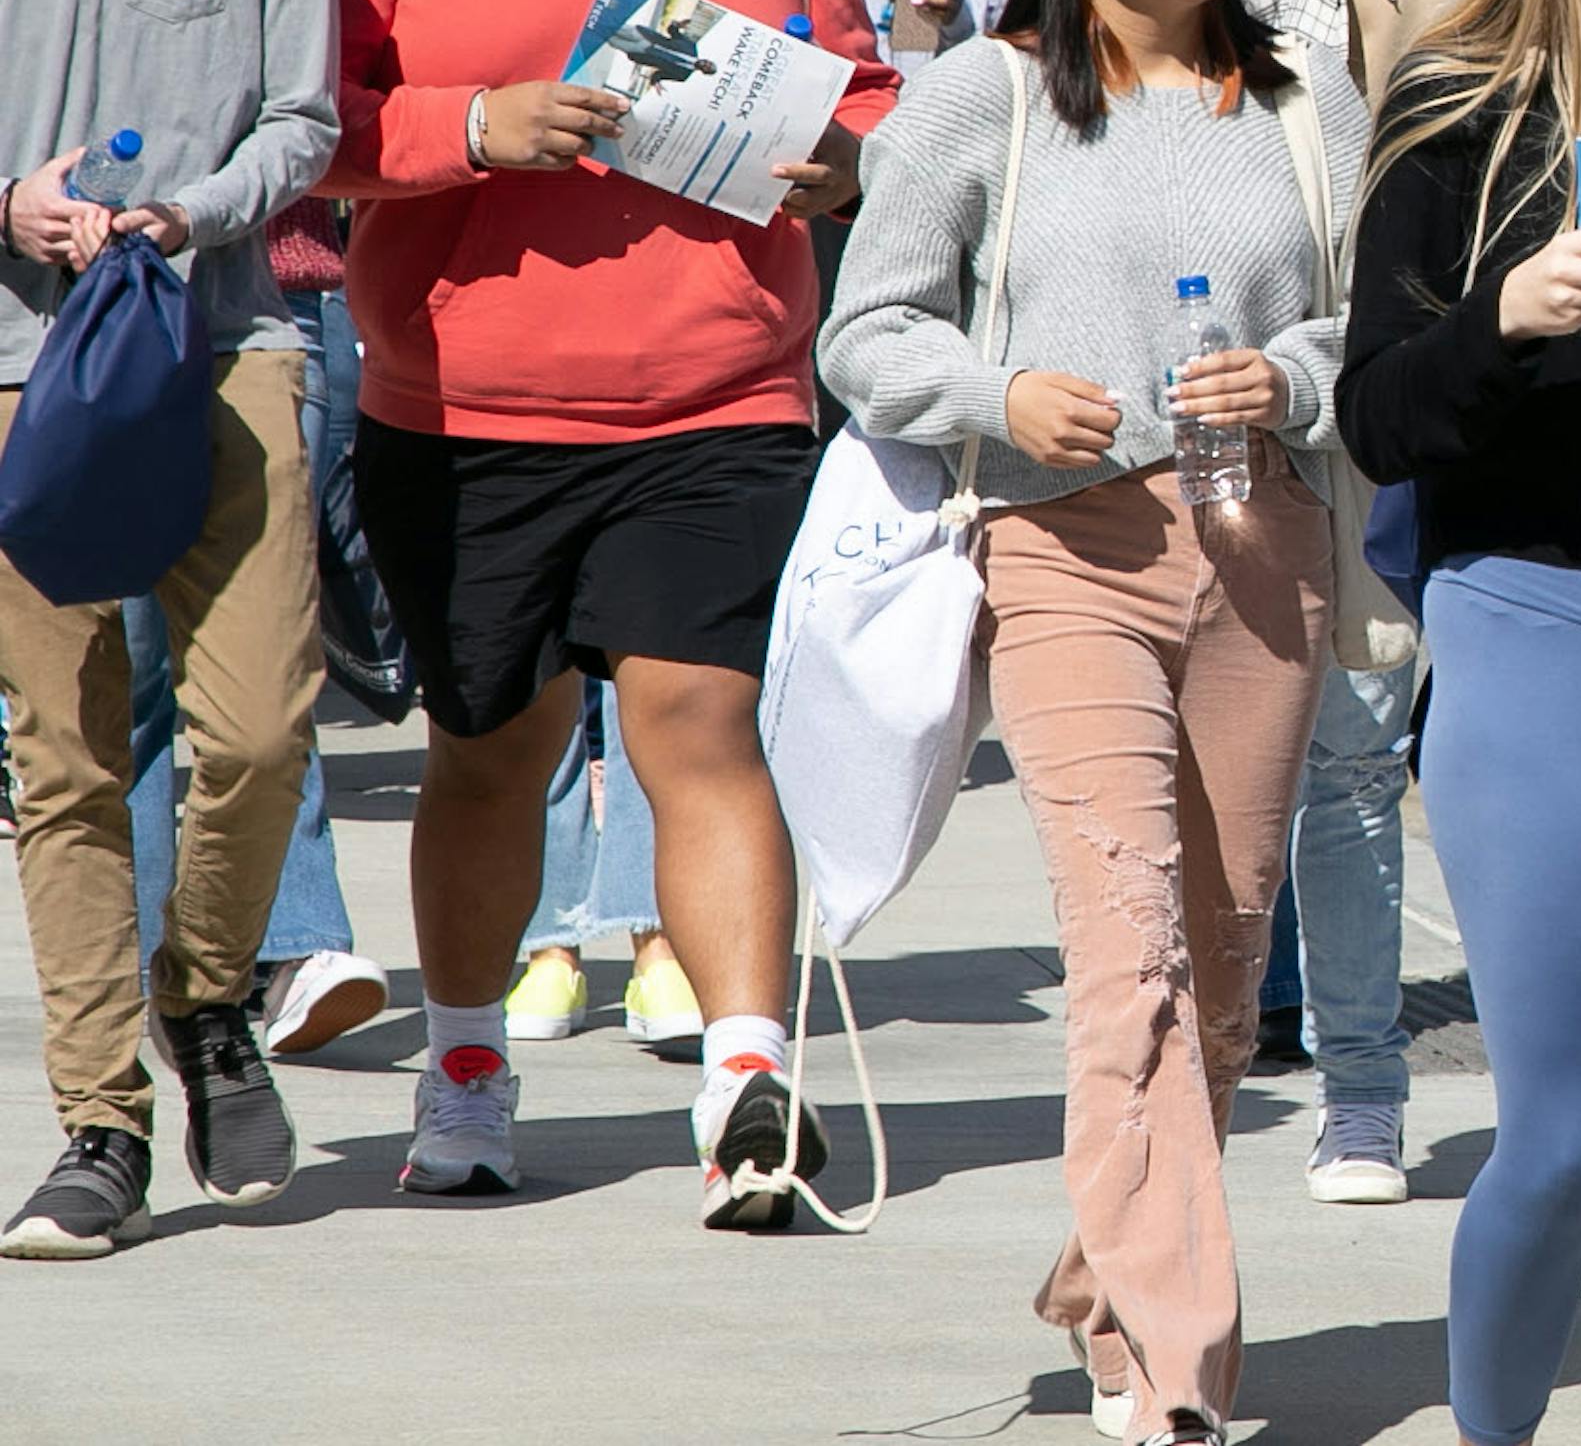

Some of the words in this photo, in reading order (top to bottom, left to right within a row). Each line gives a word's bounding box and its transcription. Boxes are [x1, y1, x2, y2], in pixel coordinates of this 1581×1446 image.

[727, 25, 755, 69] WAKE
[707, 71, 736, 111] TECH!
[736, 37, 784, 121] COMEBACK
